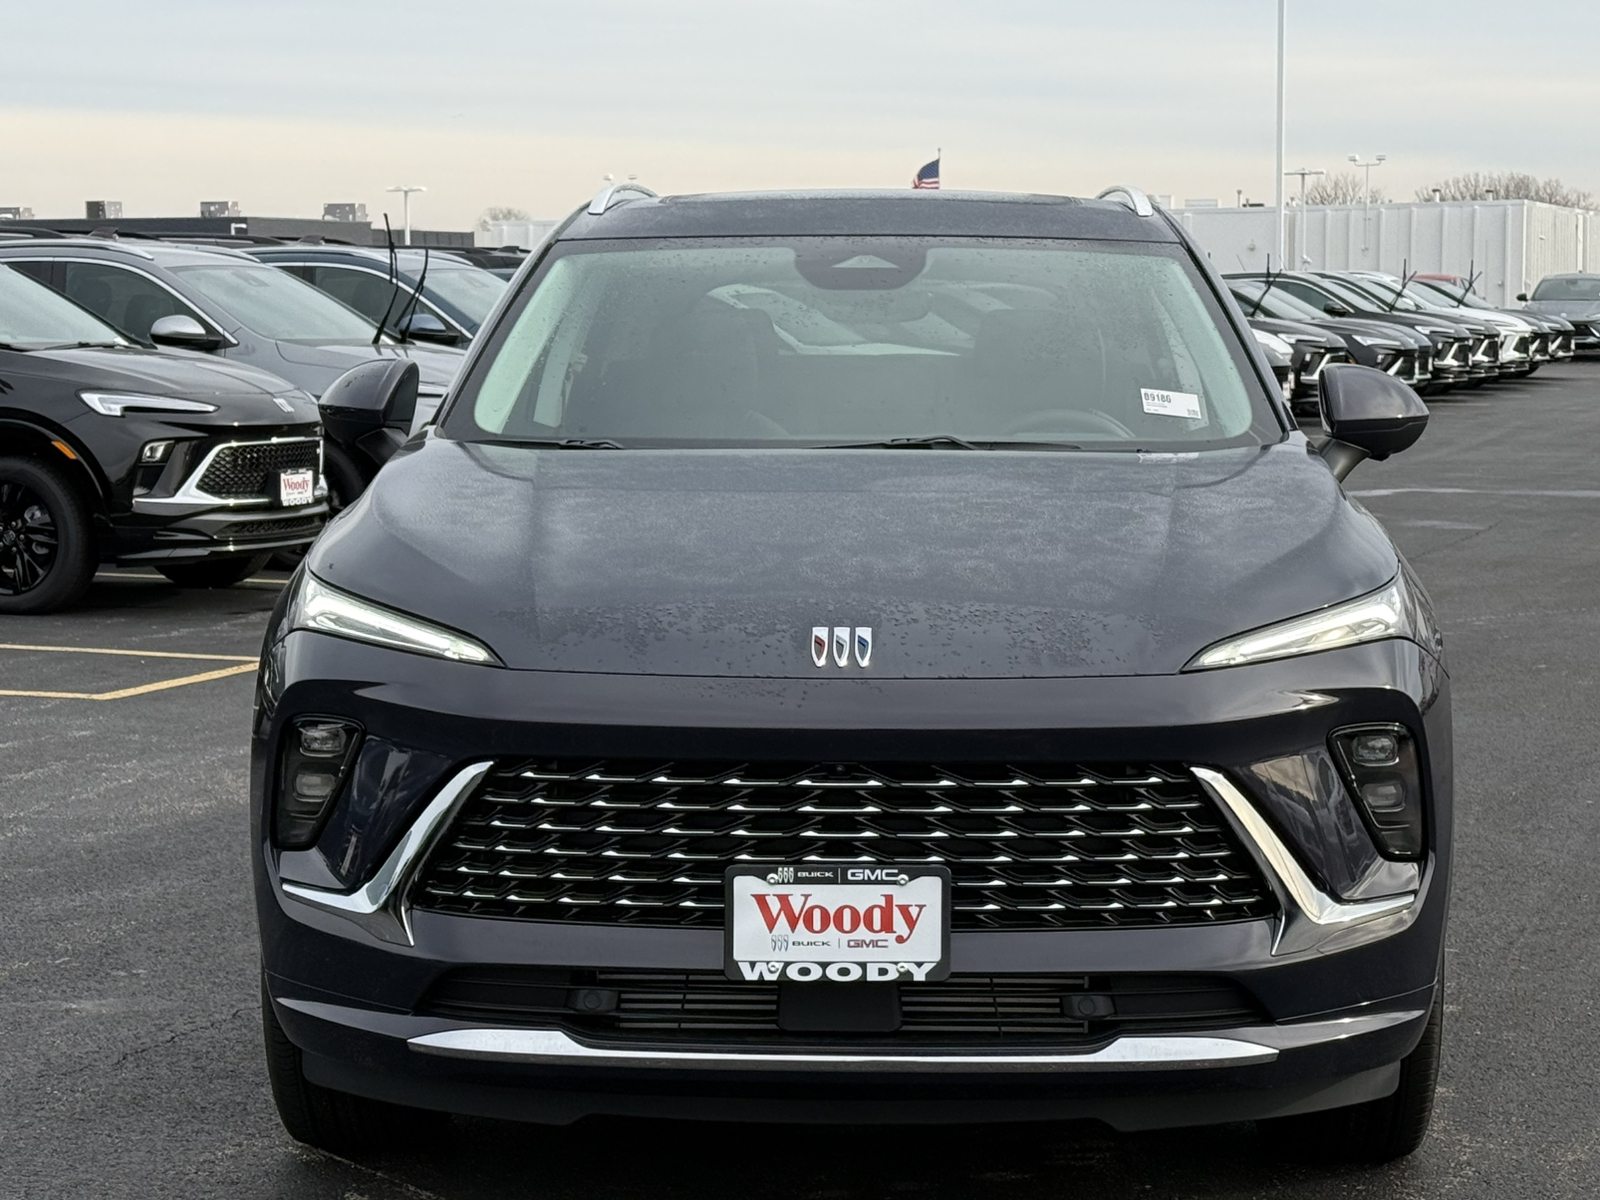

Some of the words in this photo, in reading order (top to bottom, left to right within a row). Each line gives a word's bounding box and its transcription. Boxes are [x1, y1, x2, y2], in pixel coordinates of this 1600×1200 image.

[282, 477, 310, 493] Woody
[847, 869, 899, 881] GMC
[750, 893, 927, 944] Woody
[847, 939, 889, 949] GMC
[737, 961, 938, 982] WOODY
